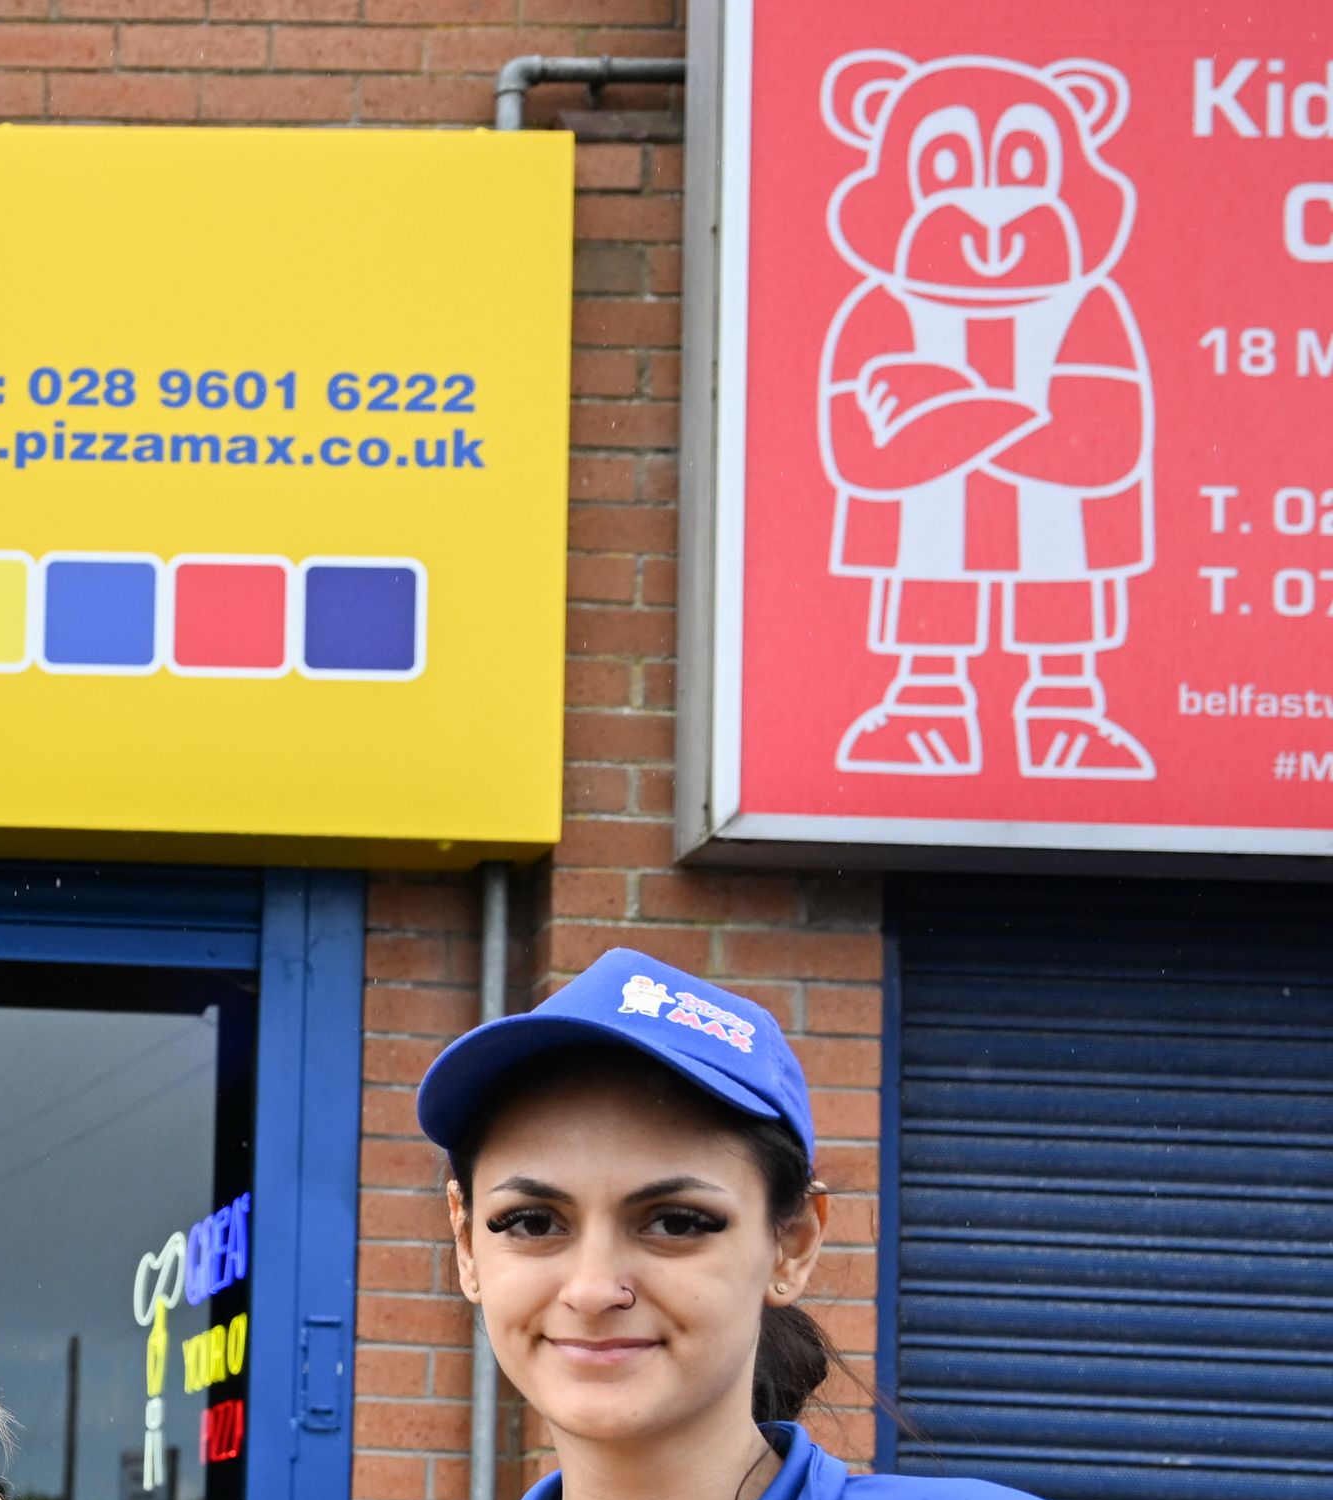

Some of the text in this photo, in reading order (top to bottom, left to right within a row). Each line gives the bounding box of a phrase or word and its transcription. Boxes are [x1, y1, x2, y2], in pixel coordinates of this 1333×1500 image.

[1191, 58, 1333, 138] Kid
[1198, 327, 1276, 377] 18
[28, 367, 136, 408] 028
[158, 370, 298, 411] 9601
[325, 373, 476, 413] 6222
[1199, 486, 1252, 535] T.
[1199, 567, 1252, 616] T.
[666, 1008, 752, 1053] MAX
